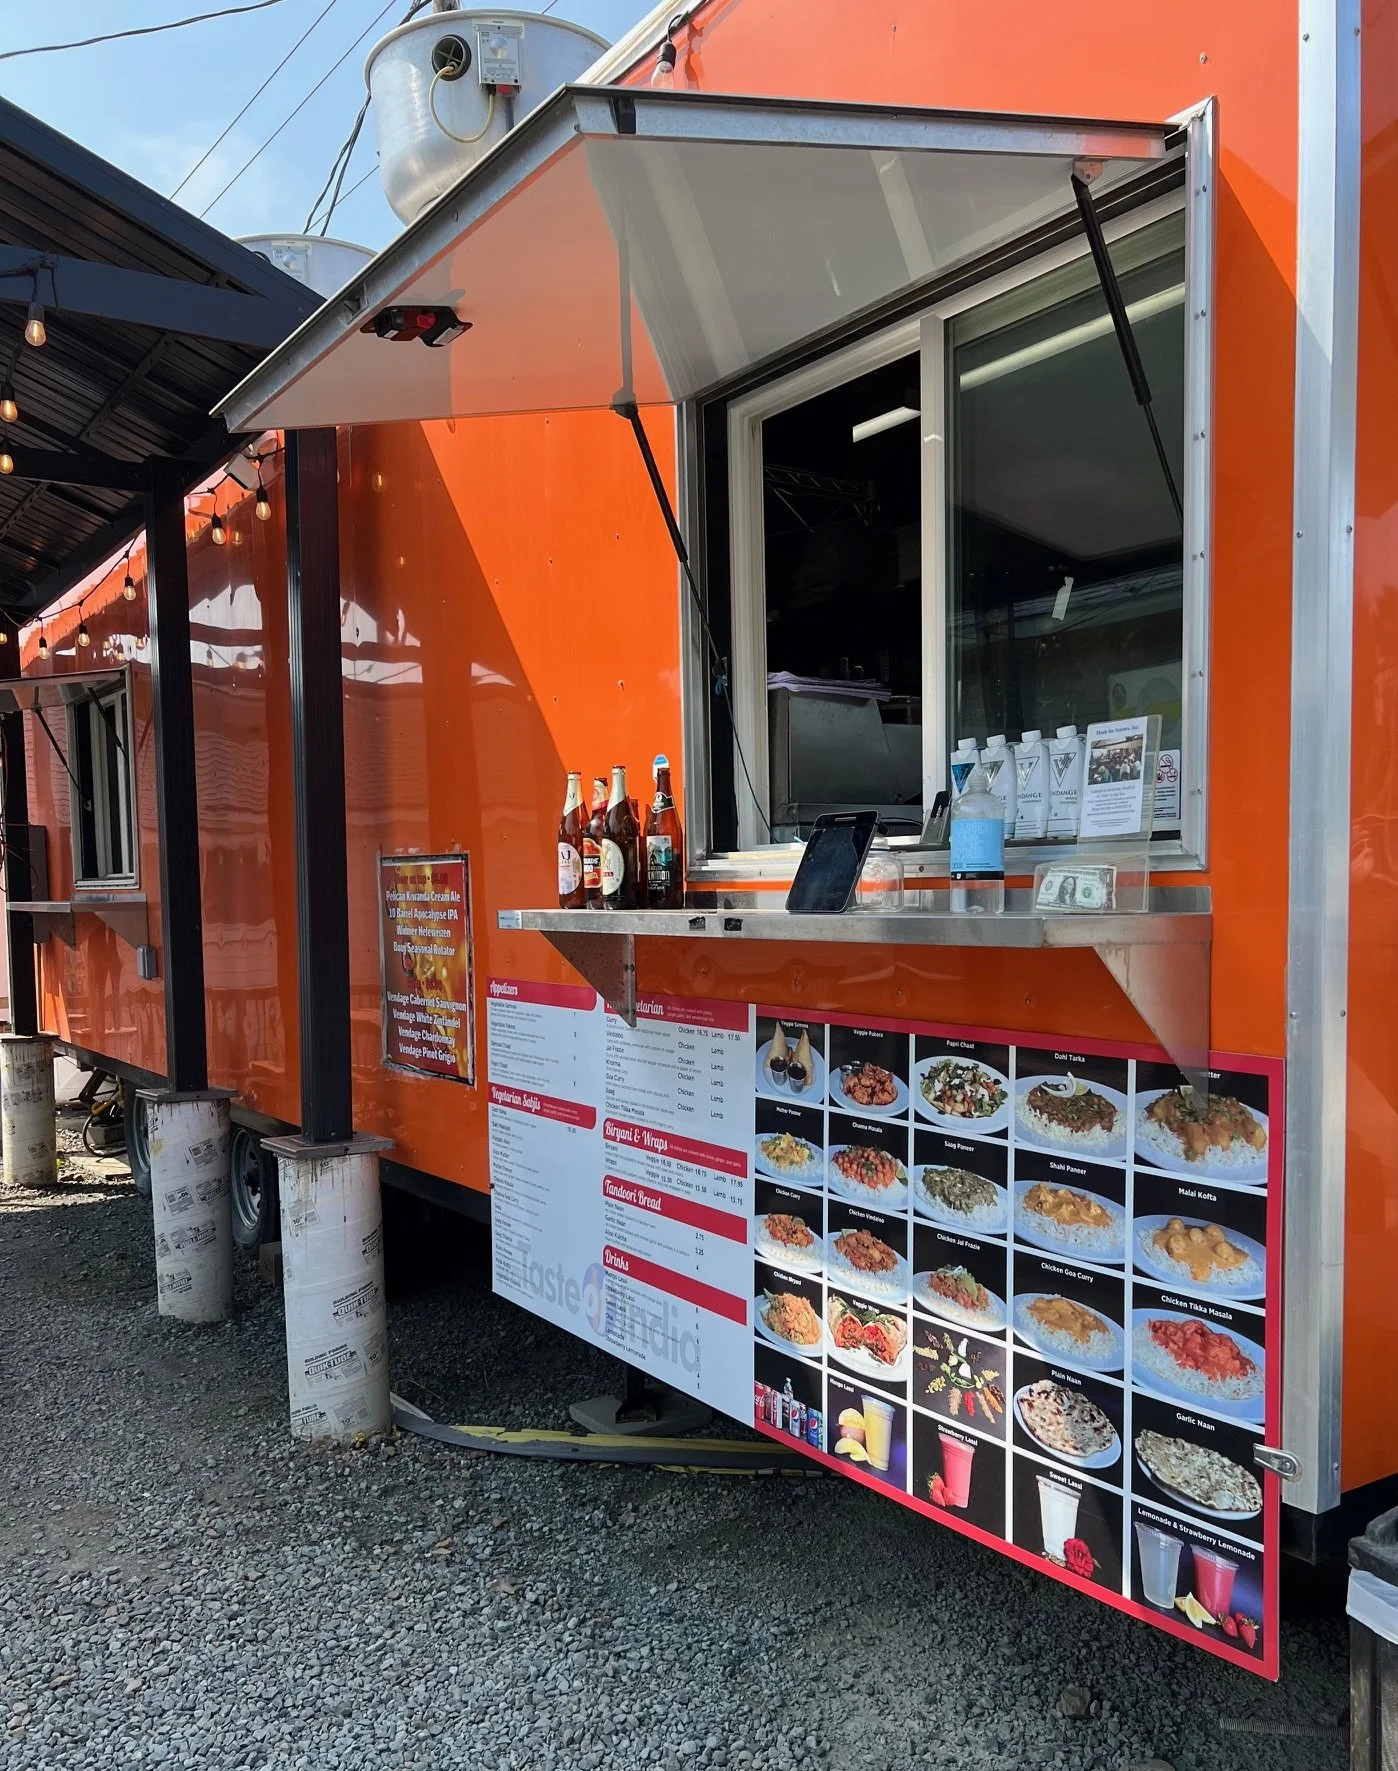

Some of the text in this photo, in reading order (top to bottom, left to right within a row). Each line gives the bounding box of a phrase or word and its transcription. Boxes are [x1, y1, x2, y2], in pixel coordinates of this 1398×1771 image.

[386, 890, 460, 902] Pelican Kiwanda Cream Ale
[389, 908, 458, 922] 10 Barrel Apocalypse IPA
[407, 942, 432, 954] Seasonal
[434, 944, 456, 956] Rotator
[490, 980, 518, 996] Appetizers
[387, 991, 466, 1013] Vendage Cabernet Sauvignon
[393, 1008, 415, 1023] Vendage
[416, 1012, 432, 1024] White
[398, 1026, 456, 1048] Vendage Chardonnay
[678, 1026, 695, 1034] Chicken
[678, 1042, 695, 1050] Chicken
[946, 1040, 974, 1050] Papri Chaat
[399, 1043, 456, 1065] Vendage Pinot Grigio
[678, 1057, 695, 1066] Chicken
[1069, 1055, 1086, 1063] Tarka
[678, 1072, 695, 1081] Chicken
[491, 1086, 522, 1106] Vegetarian
[522, 1094, 541, 1112] Sabjis
[677, 1088, 694, 1097] Chicken
[711, 1095, 724, 1103] Lamb
[677, 1103, 694, 1112] Chicken
[710, 1111, 723, 1119] Lamb
[852, 1122, 883, 1134] Channa Masala
[605, 1121, 668, 1154] Biryani & Wraps
[944, 1140, 974, 1152] Saag Paneer
[677, 1163, 694, 1172] Chicken
[714, 1174, 726, 1182] Lamb
[1050, 1162, 1087, 1175] Shahi Paneer
[605, 1180, 637, 1203] Tandoori
[638, 1190, 662, 1211] Bread
[677, 1178, 694, 1188] Chicken
[714, 1190, 726, 1199] Lamb
[775, 1188, 801, 1200] Chicken Curry
[1178, 1187, 1217, 1202] Malai Kofta
[849, 1209, 885, 1223] Chicken Vindaloo
[695, 1233, 704, 1241] 2.75
[936, 1233, 956, 1244] Chicken
[965, 1240, 981, 1250] Frazie
[605, 1249, 629, 1271] Drinks
[517, 1239, 580, 1314] Taste
[773, 1271, 788, 1281] Chicken
[1041, 1262, 1094, 1284] Chicken Goa Curry
[853, 1299, 867, 1310] Veggie
[1161, 1295, 1233, 1320] Chicken Tikka Masala
[830, 1377, 844, 1389] Mango
[1052, 1370, 1082, 1386] Plain Naan
[1176, 1412, 1215, 1431] Garlic Naan
[938, 1424, 978, 1446] Strawberry Lassi
[1049, 1471, 1083, 1490] Sweet Lassi
[1138, 1507, 1172, 1527] Lemonade
[1179, 1524, 1217, 1546] Strawberry
[1218, 1539, 1256, 1561] Lemonade
